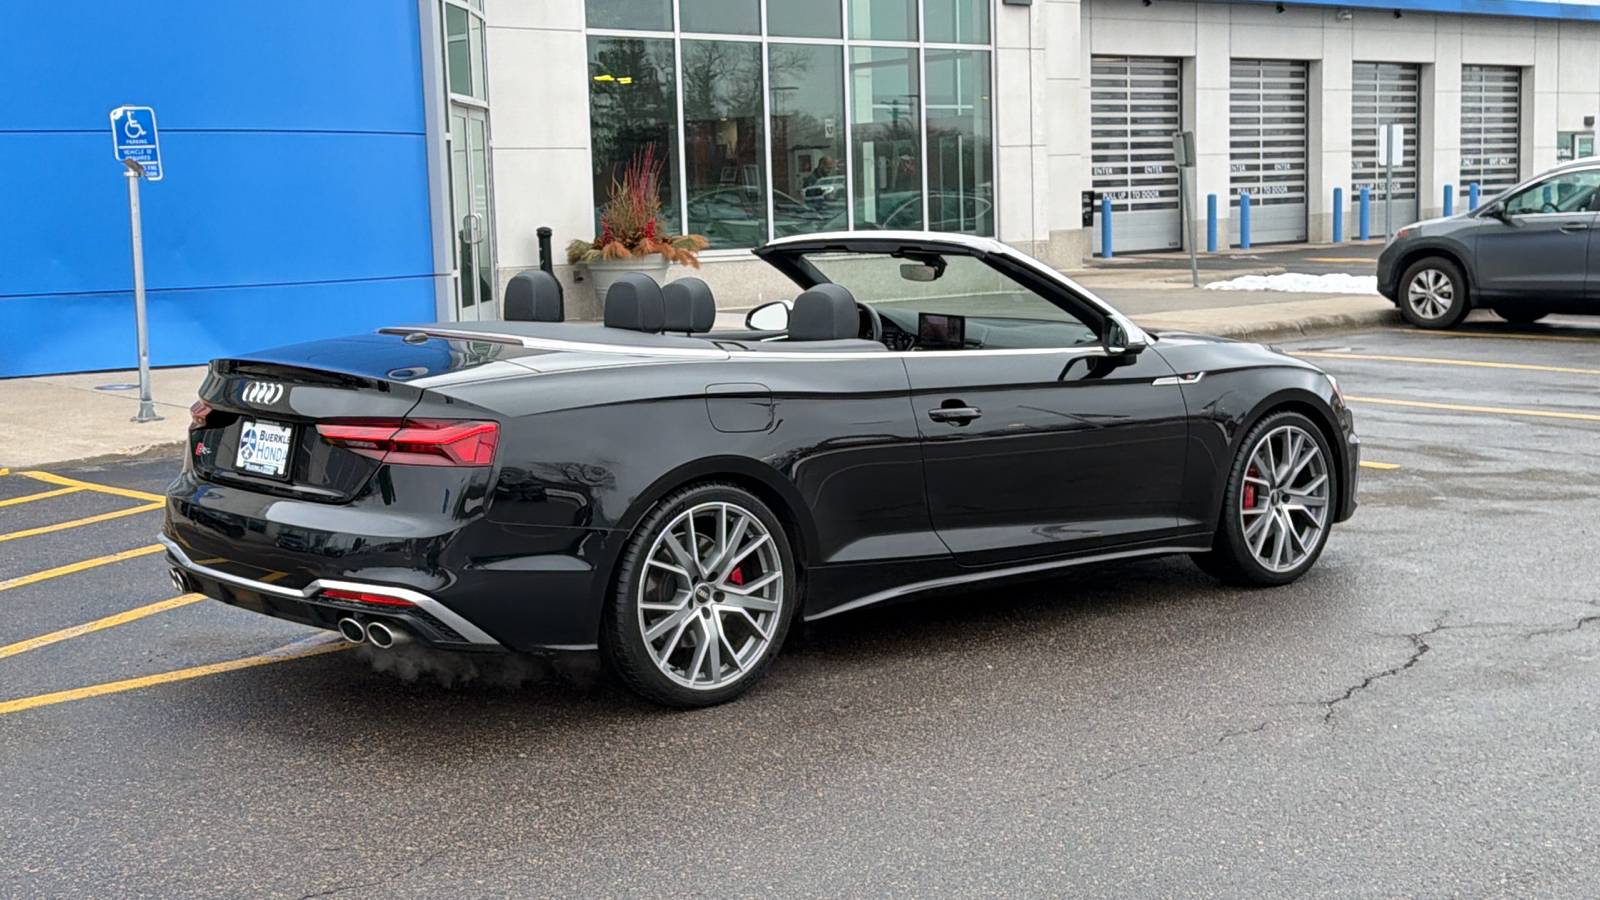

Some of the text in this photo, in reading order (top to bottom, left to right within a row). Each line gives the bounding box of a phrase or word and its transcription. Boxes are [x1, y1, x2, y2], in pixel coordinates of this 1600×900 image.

[1094, 167, 1113, 176] ENTER
[1144, 165, 1163, 174] ENTER
[1274, 163, 1291, 171] ENTER
[1118, 190, 1127, 199] UP
[1132, 191, 1140, 199] TO
[1141, 189, 1160, 199] DOOR
[259, 430, 290, 444] BUERKLE
[256, 441, 287, 462] HONDA
